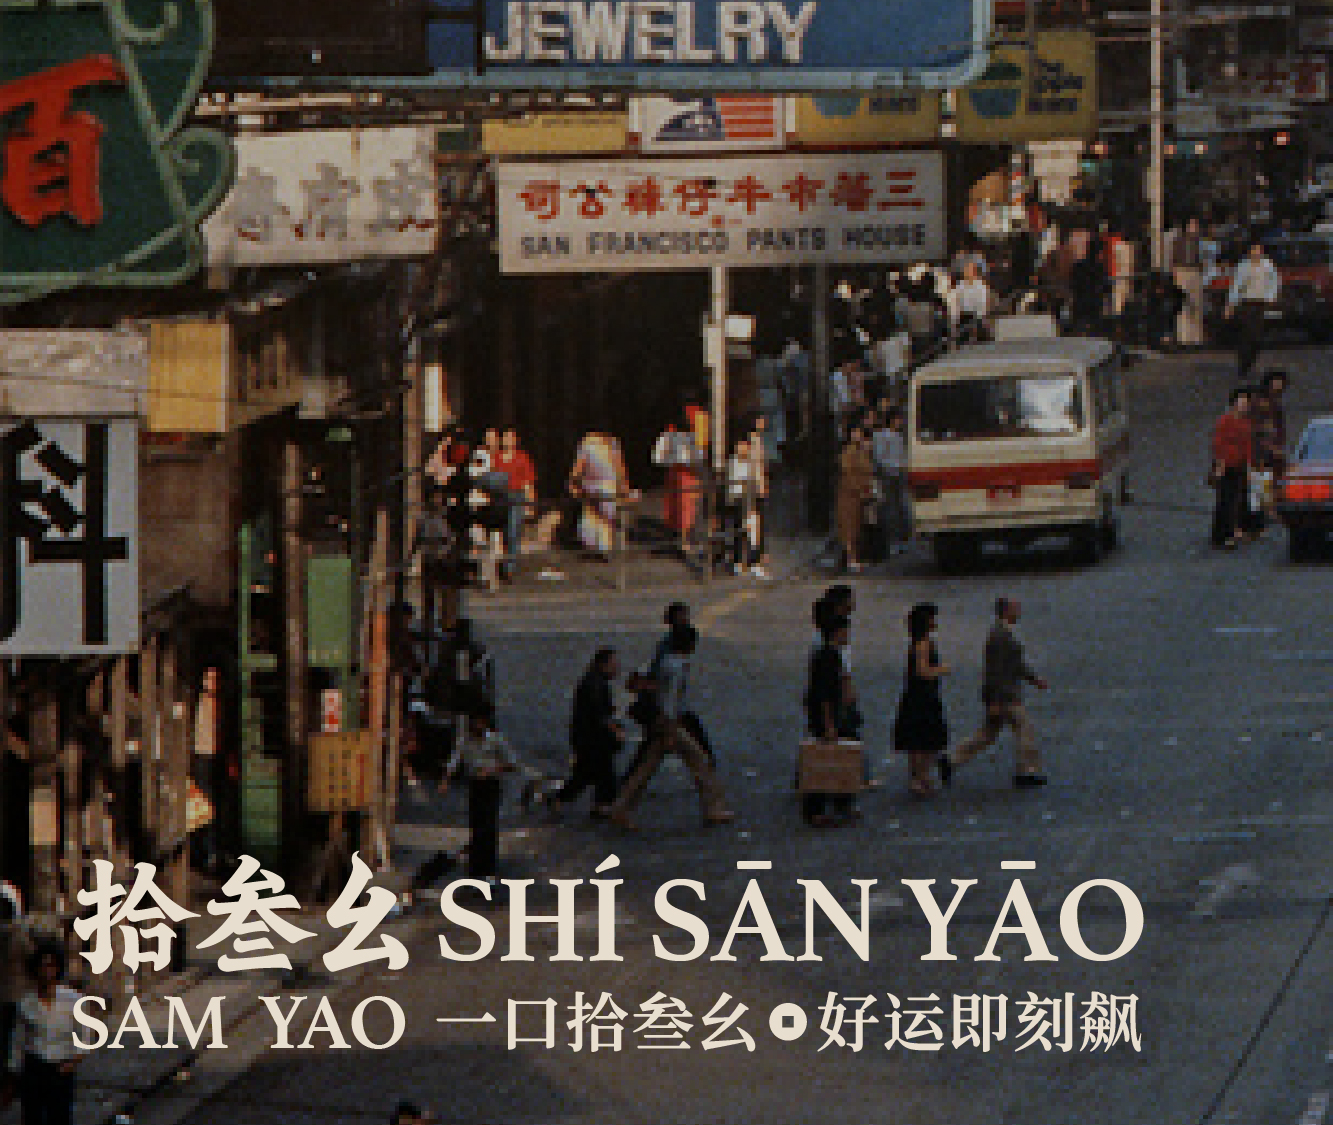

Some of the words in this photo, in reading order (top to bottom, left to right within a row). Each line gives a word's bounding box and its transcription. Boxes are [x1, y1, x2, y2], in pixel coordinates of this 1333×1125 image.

[484, 0, 818, 65] JEWELRY
[518, 234, 570, 257] SAN
[587, 231, 729, 256] FRANCISCO
[747, 227, 827, 252] PANTS
[843, 223, 927, 249] HOUSE
